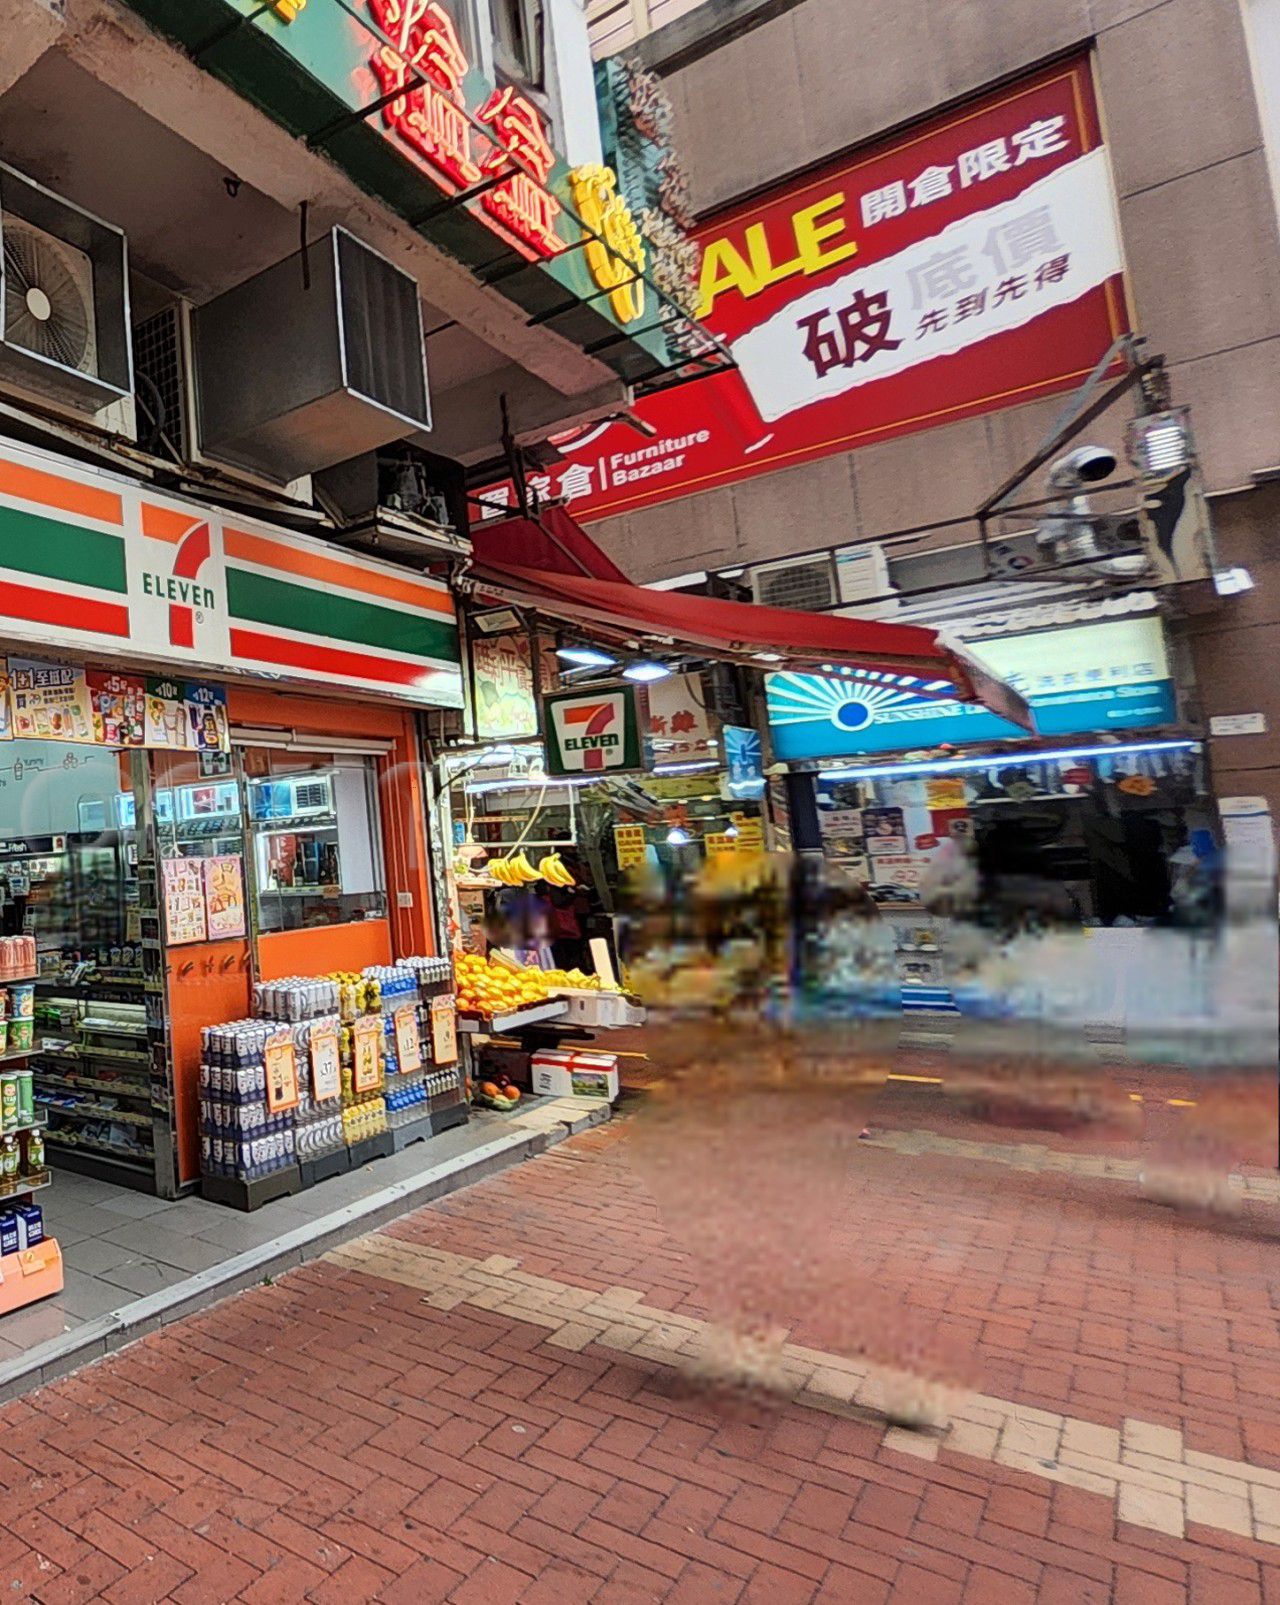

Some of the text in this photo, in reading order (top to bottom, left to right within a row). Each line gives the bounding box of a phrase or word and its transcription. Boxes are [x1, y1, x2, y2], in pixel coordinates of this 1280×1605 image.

[860, 114, 1070, 228] 開倉限定
[694, 192, 858, 319] ALE
[914, 253, 1071, 341] 先到先得
[610, 429, 710, 470] Furniture
[612, 453, 686, 486] Bazaar
